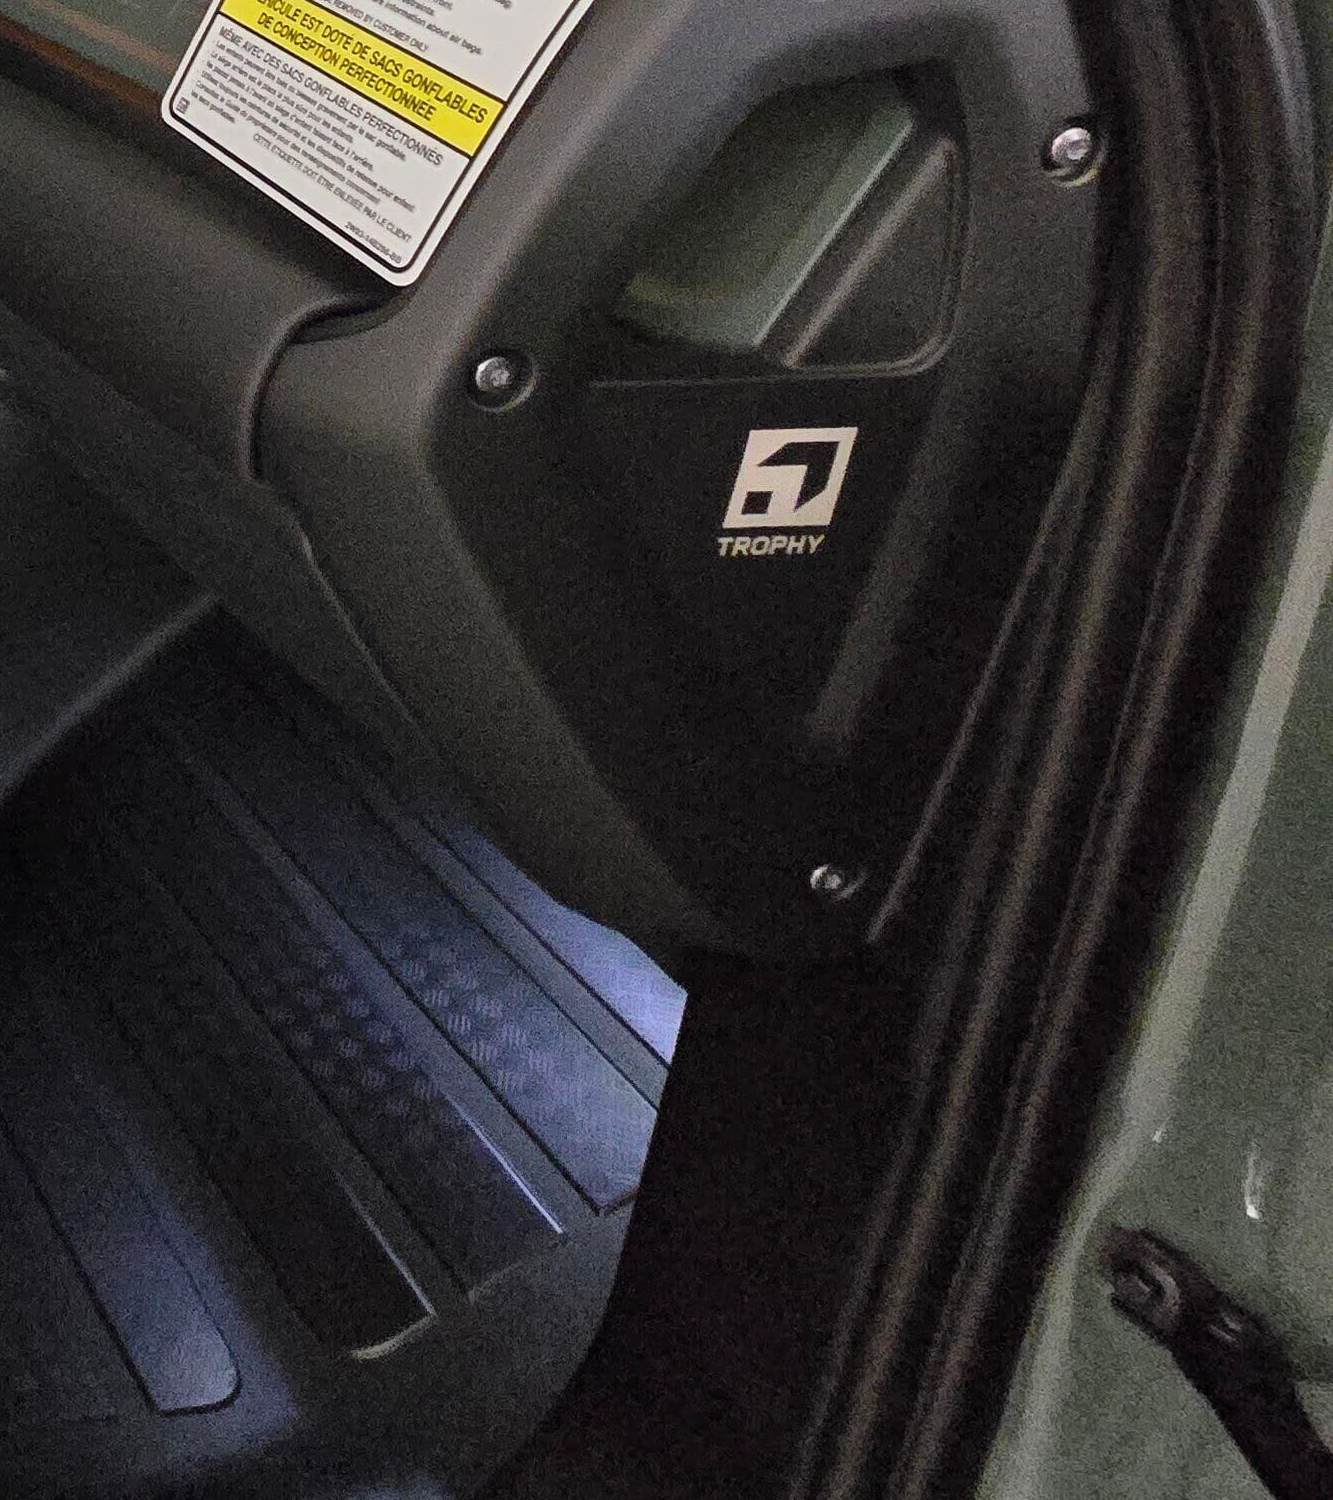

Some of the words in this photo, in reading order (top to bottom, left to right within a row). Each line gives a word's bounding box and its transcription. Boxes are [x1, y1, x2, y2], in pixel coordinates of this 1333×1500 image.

[241, 40, 264, 58] AVEC
[262, 52, 281, 69] DES
[280, 63, 304, 83] SACS
[303, 76, 363, 118] GONFLABLES
[257, 11, 274, 29] DE
[272, 20, 341, 66] CONCEPTION
[338, 57, 436, 121] PERFECTIONNÉE
[299, 12, 324, 32] EST
[351, 40, 371, 60] DE
[368, 50, 403, 77] SACS
[402, 68, 487, 123] GONFLABLES
[717, 534, 825, 557] TROPHY
